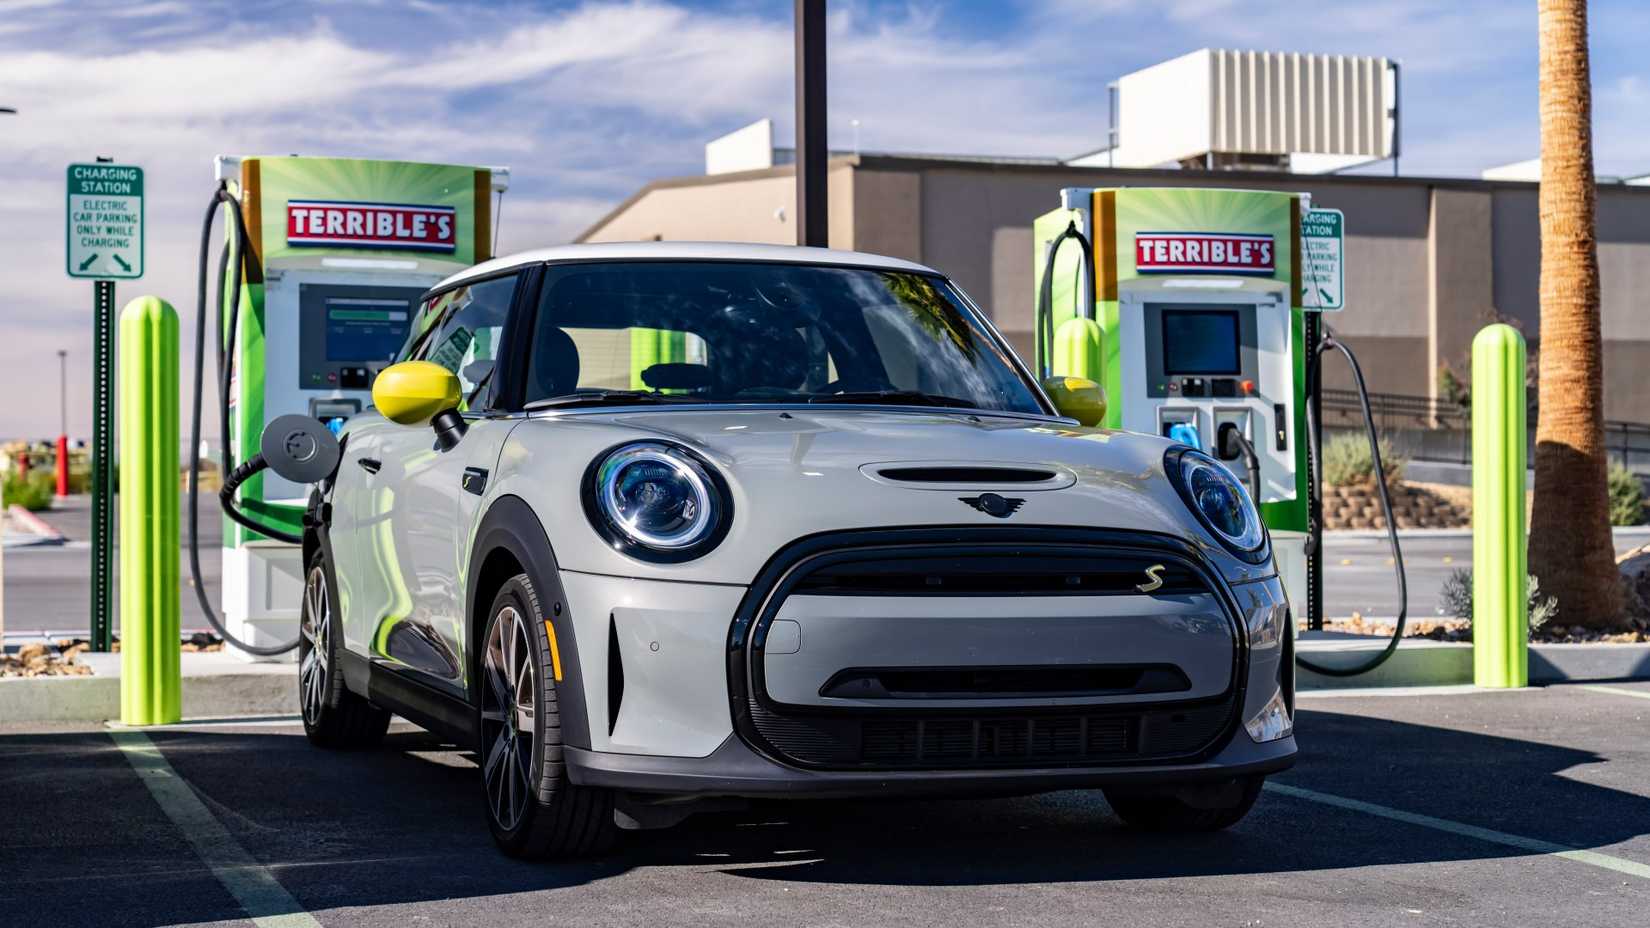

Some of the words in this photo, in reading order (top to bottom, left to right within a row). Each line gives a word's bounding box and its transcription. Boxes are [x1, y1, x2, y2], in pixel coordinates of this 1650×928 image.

[74, 167, 137, 180] CHARGING
[81, 181, 130, 193] STATION
[83, 200, 128, 211] ELECTRIC
[73, 212, 92, 223] CAR
[96, 213, 137, 224] PARKING
[291, 209, 450, 239] TERRIBLE'S
[1303, 213, 1337, 224] ARGING
[77, 225, 102, 236] ONLY
[105, 226, 134, 237] WHILE
[1300, 225, 1333, 236] TATION
[81, 237, 129, 248] CHARGING
[1139, 240, 1271, 264] TERRIBLE'S
